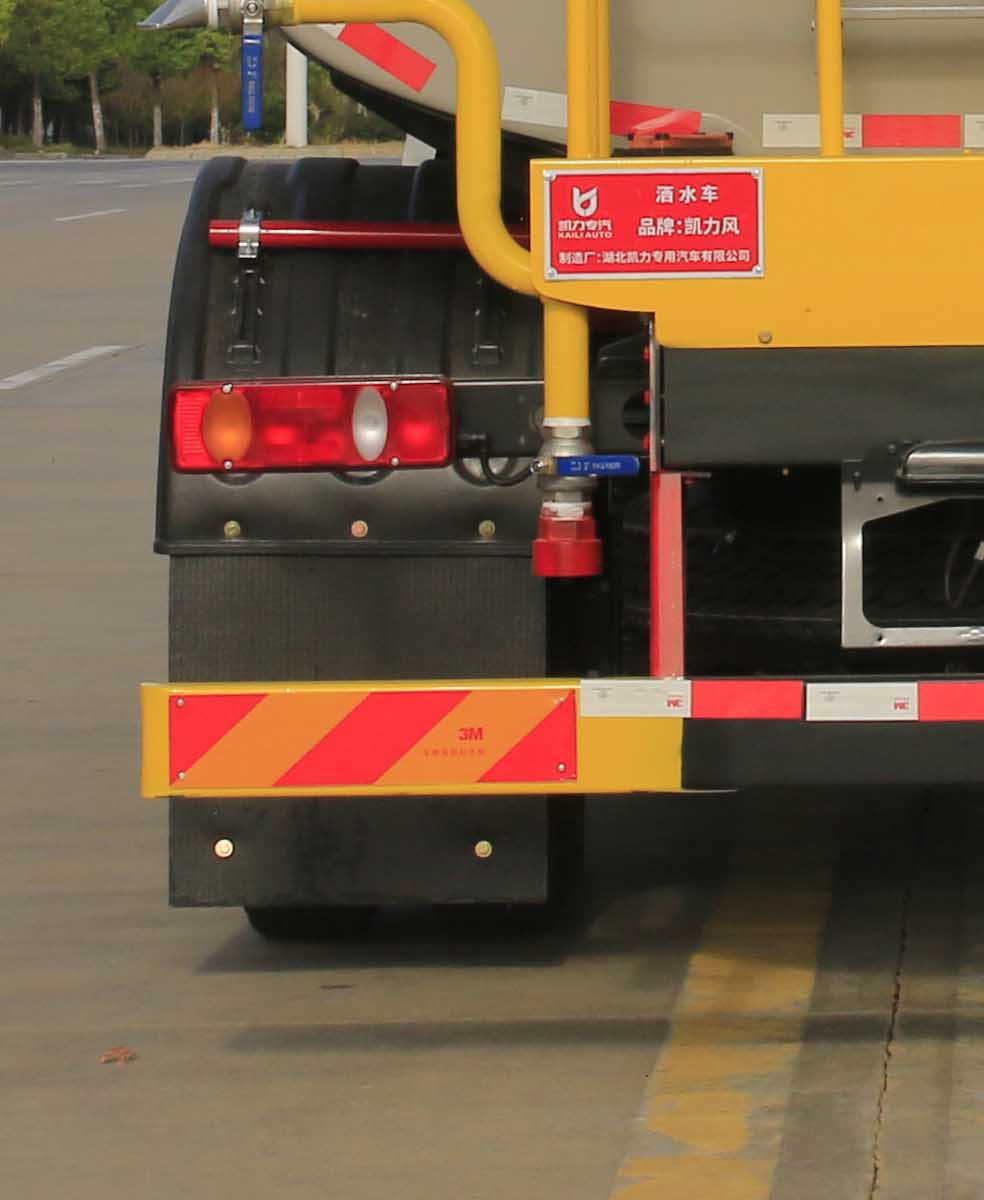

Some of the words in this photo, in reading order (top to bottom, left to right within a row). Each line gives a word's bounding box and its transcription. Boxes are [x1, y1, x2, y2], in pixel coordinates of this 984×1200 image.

[656, 185, 719, 203] 洒水车
[558, 219, 612, 231] 凯力专汽
[638, 216, 740, 236] 品牌：凯力风
[585, 231, 612, 239] AUTO
[559, 250, 750, 265] 制造厂：湖北凯力专用汽车有限公司
[458, 727, 483, 741] 3M
